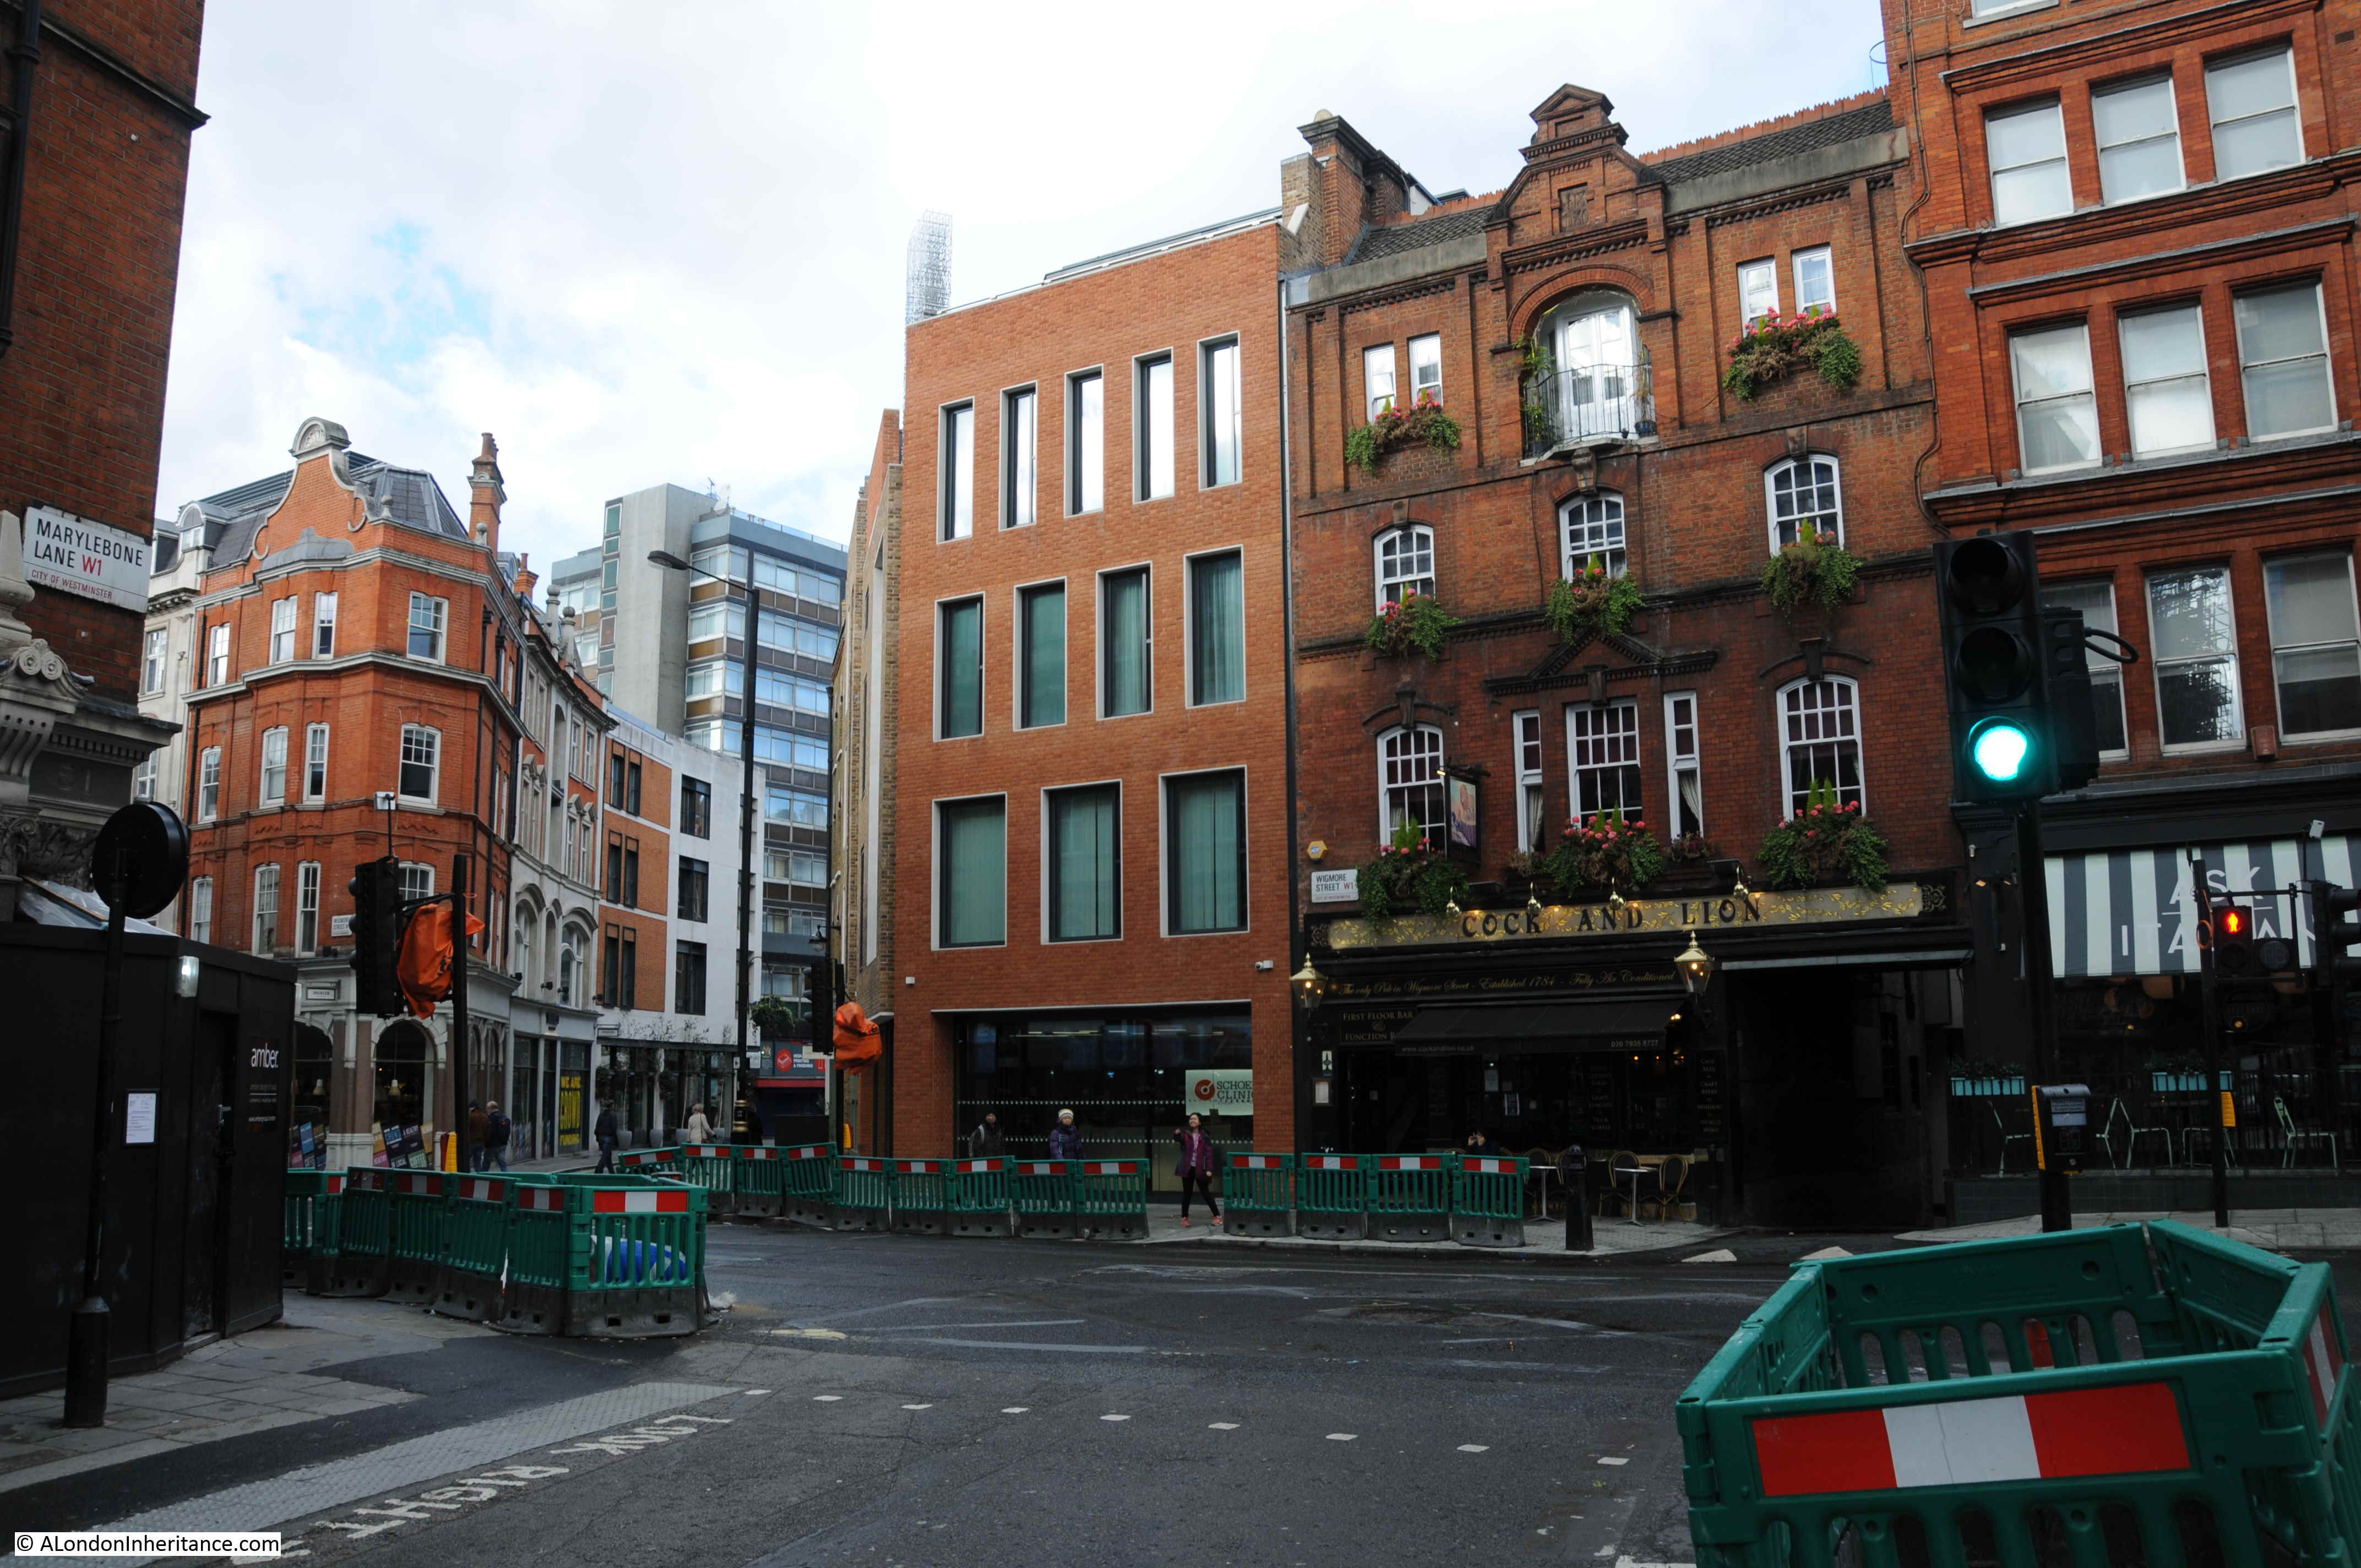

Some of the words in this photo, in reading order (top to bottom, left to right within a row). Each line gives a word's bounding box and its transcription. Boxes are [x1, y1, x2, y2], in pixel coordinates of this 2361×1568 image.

[34, 541, 75, 568] LANE
[82, 554, 102, 576] W1
[36, 518, 143, 567] MARYLEBONE
[31, 569, 48, 581] CITY
[51, 574, 59, 584] OF
[62, 578, 112, 599] WESTMINSTER
[1316, 873, 1347, 883] WIGMORE
[1316, 883, 1339, 892] STREET
[2169, 867, 2264, 904] ASK
[1462, 911, 1542, 937] COCK
[1578, 907, 1643, 932] AND
[1682, 898, 1760, 925] LION
[1343, 1012, 1364, 1021] FIRST
[1368, 1012, 1395, 1020] FLOOR
[1217, 1081, 1251, 1090] SCHOE
[550, 1414, 733, 1455] LOOK
